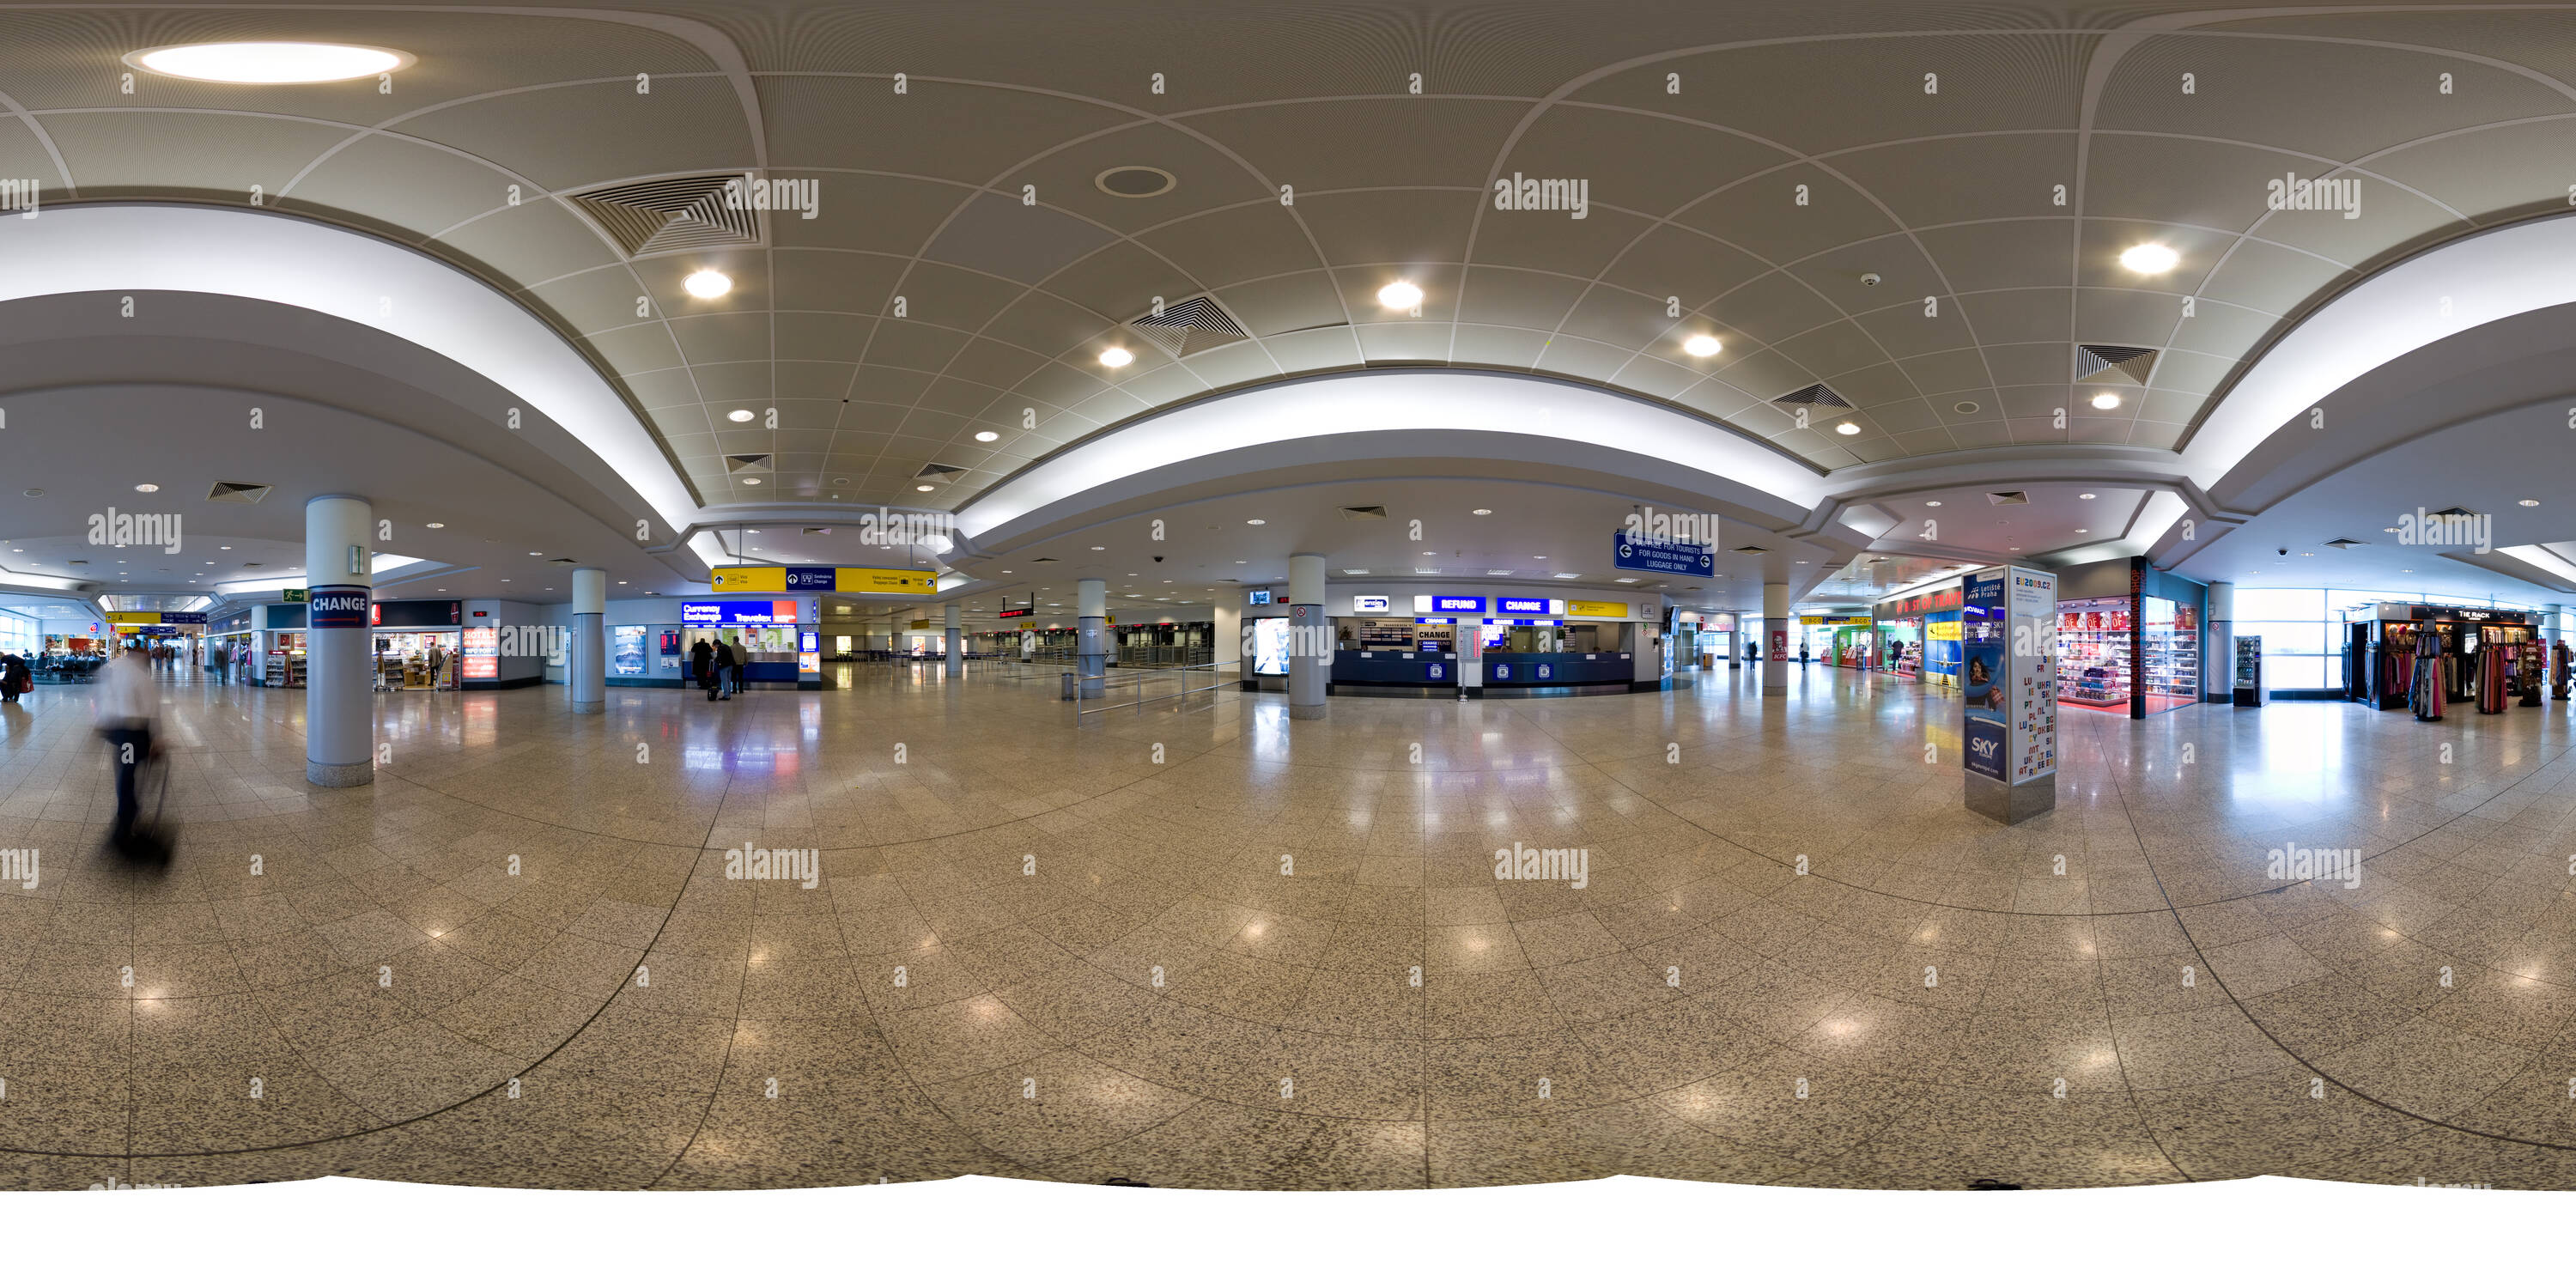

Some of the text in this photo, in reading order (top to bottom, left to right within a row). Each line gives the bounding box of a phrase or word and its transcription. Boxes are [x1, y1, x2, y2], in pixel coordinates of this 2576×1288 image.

[1648, 541, 1662, 550] FREE
[1675, 544, 1701, 555] TOURISTS
[1651, 550, 1672, 560] GOODS
[1680, 554, 1694, 563] HAND
[1646, 560, 1687, 571] LUGGAGE ONLY
[2015, 577, 2050, 590] EU2009.CZ
[2131, 569, 2140, 593] SHOP
[313, 597, 365, 611] CHANGE
[1441, 599, 1477, 610] REFUND
[1505, 600, 1541, 611] CHANGE
[1922, 595, 1933, 610] OF
[1935, 591, 1962, 608] TRAVE
[683, 605, 720, 614] Currency
[2131, 595, 2140, 634] ARRIVAL
[683, 613, 722, 623] Exchange
[734, 614, 772, 623] Travelex
[2065, 618, 2075, 628] OF
[2087, 618, 2097, 628] OF
[2112, 617, 2123, 628] OF
[2037, 665, 2044, 673] FR
[2131, 641, 2140, 696] DEPARTURE
[2024, 677, 2032, 686] LU
[2028, 687, 2034, 696] IE
[2042, 690, 2050, 698] SK
[2024, 700, 2032, 709] PT
[2029, 712, 2037, 721] PL
[2028, 723, 2037, 732] DE
[2038, 726, 2046, 735] DK
[1971, 737, 1999, 756] SKY
[2046, 750, 2053, 758] EL
[2024, 756, 2033, 764] UK
[2038, 760, 2045, 769] EE
